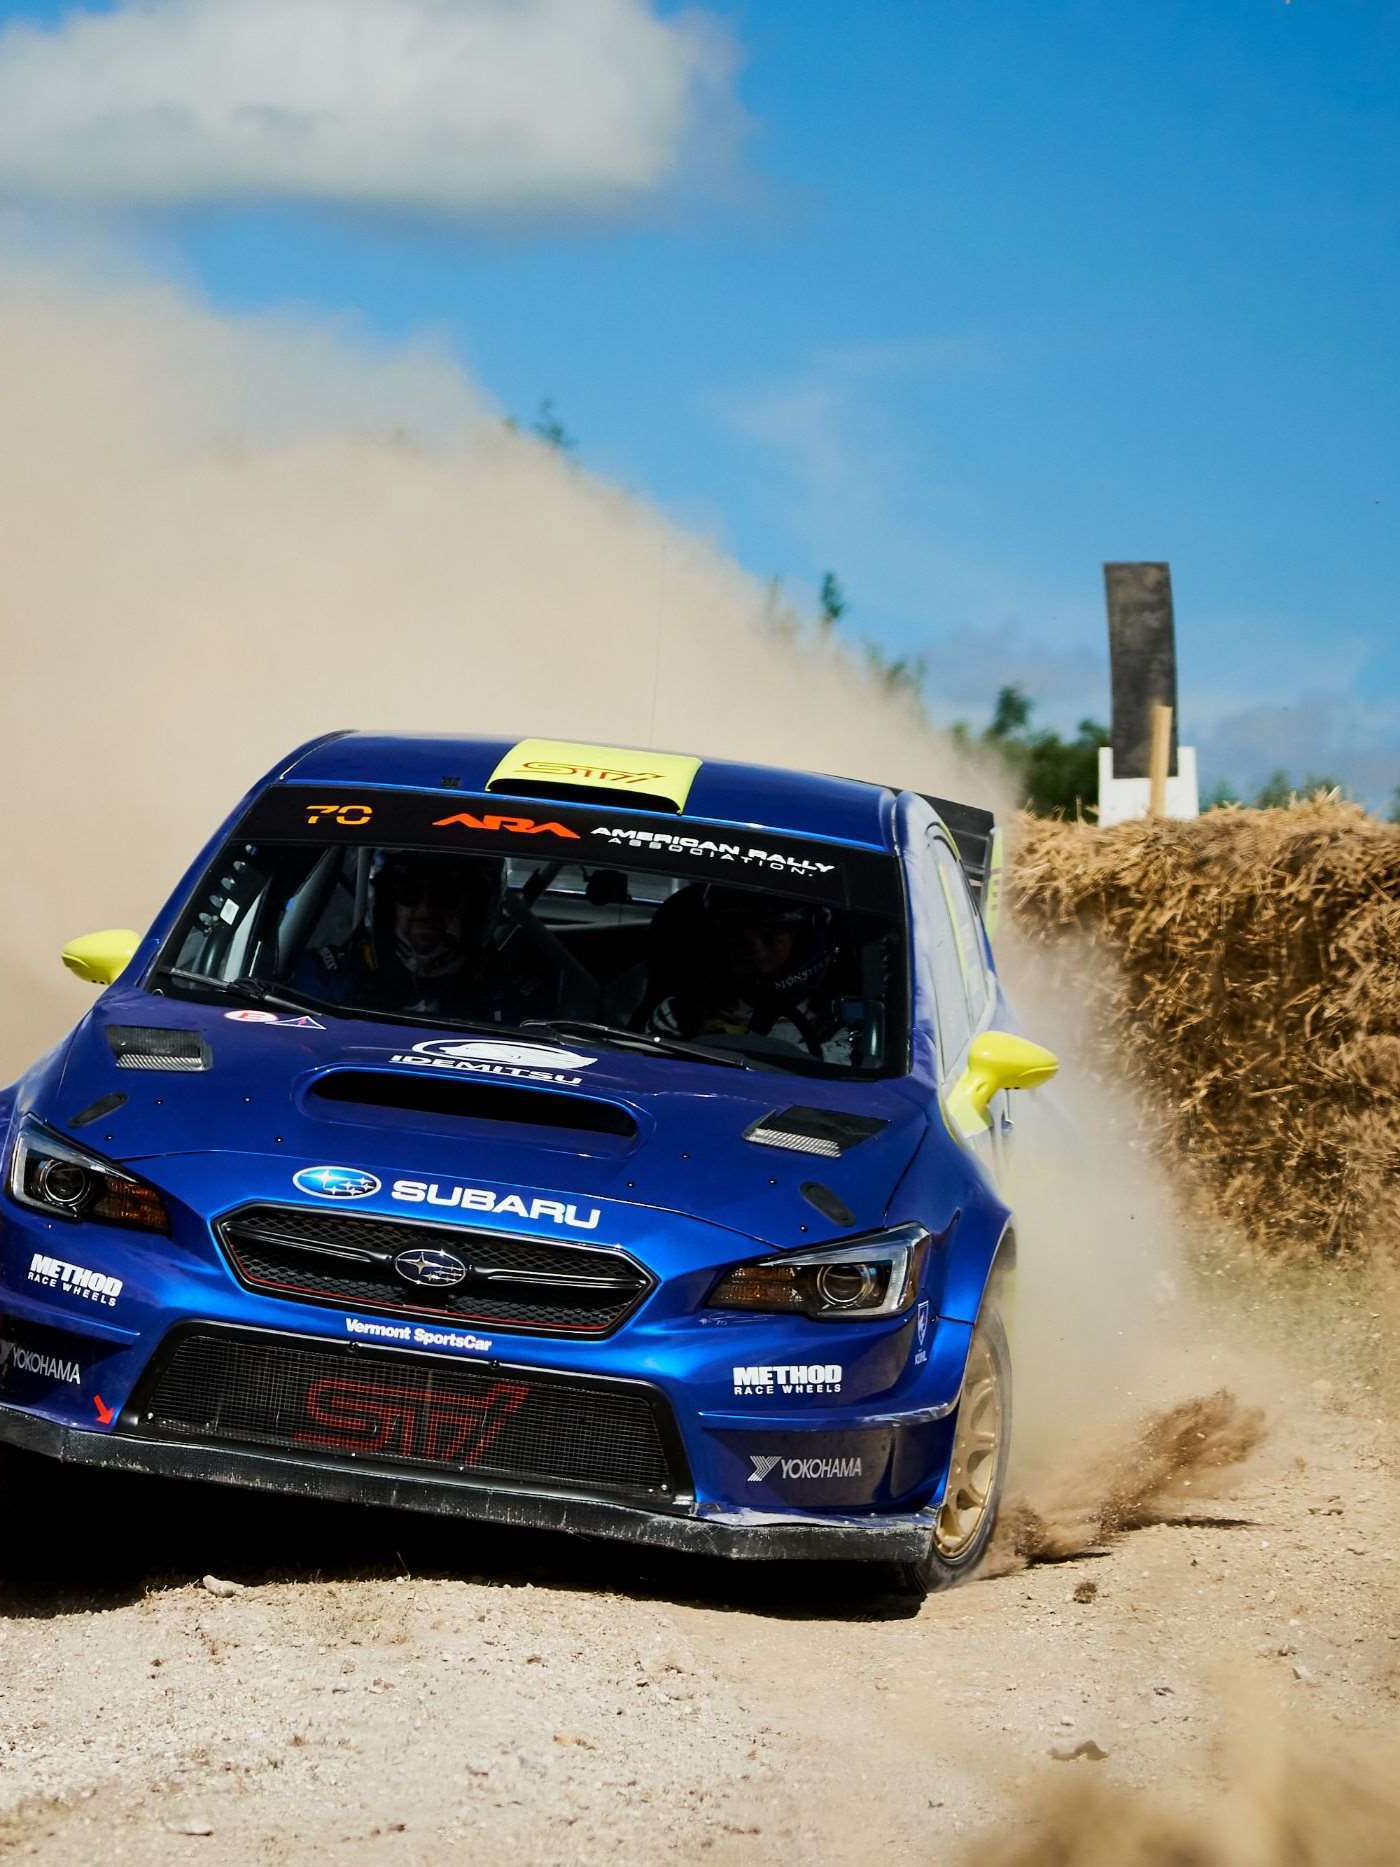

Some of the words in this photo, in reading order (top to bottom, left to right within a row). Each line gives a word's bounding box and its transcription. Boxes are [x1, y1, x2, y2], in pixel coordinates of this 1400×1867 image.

[306, 805, 373, 825] 70
[432, 813, 581, 839] ARA
[590, 827, 740, 854] AMERICAN
[748, 848, 836, 873] RALLY
[388, 1054, 583, 1087] IDEMITSU
[391, 1179, 601, 1230] SUBARU
[27, 1271, 57, 1288] RACE
[62, 1282, 117, 1307] WHEELS
[30, 1253, 123, 1297] METHOD
[345, 1317, 412, 1340] Vermont
[413, 1327, 493, 1351] SportsCar
[13, 1346, 81, 1385] YOKOHAMA
[733, 1364, 843, 1386] METHOD
[734, 1385, 775, 1396] RACE
[782, 1383, 842, 1395] WHEELS
[780, 1456, 863, 1480] YOKOHAMA
